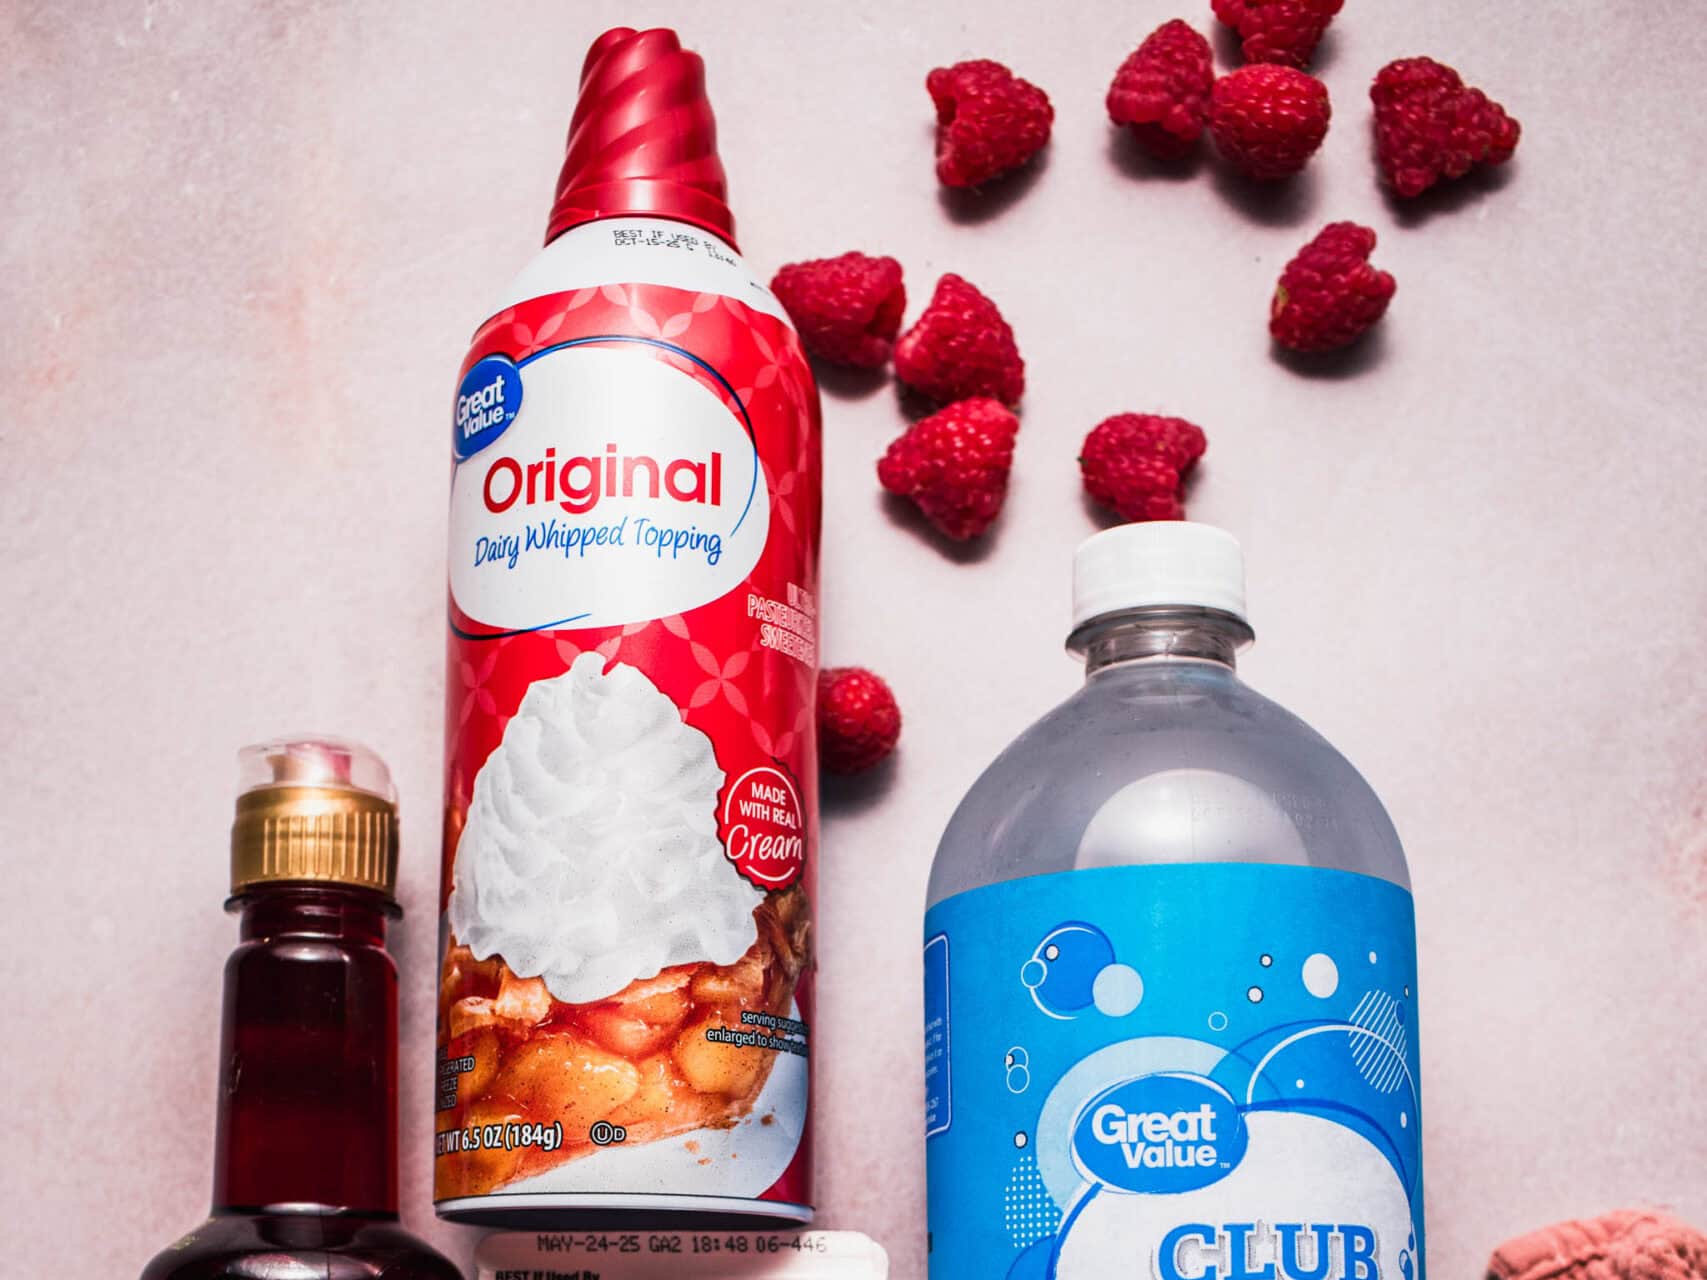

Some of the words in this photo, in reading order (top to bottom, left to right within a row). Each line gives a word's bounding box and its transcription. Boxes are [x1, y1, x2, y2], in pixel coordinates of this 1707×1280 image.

[613, 230, 642, 238] BEST
[456, 375, 505, 426] Great
[464, 406, 504, 439] Value
[484, 443, 722, 515] Original
[474, 533, 520, 569] Dairy
[525, 516, 628, 558] Whipped
[633, 518, 722, 566] Topping
[751, 781, 786, 806] MADE
[739, 799, 770, 822] WITH
[773, 807, 797, 830] REAL
[726, 824, 802, 861] Cream
[742, 1011, 776, 1030] serving
[707, 1028, 755, 1047] enlarged
[757, 1034, 767, 1046] to
[446, 1130, 461, 1152] WT
[462, 1128, 480, 1150] 6.5
[483, 1126, 503, 1147] OZ
[505, 1122, 562, 1150] (184g)
[1091, 1104, 1217, 1144] Great
[1121, 1140, 1217, 1169] Value
[536, 1235, 641, 1252] MAY-24-25
[648, 1235, 681, 1252] GA2
[692, 1235, 748, 1253] 18:48
[756, 1235, 827, 1253] 06-446
